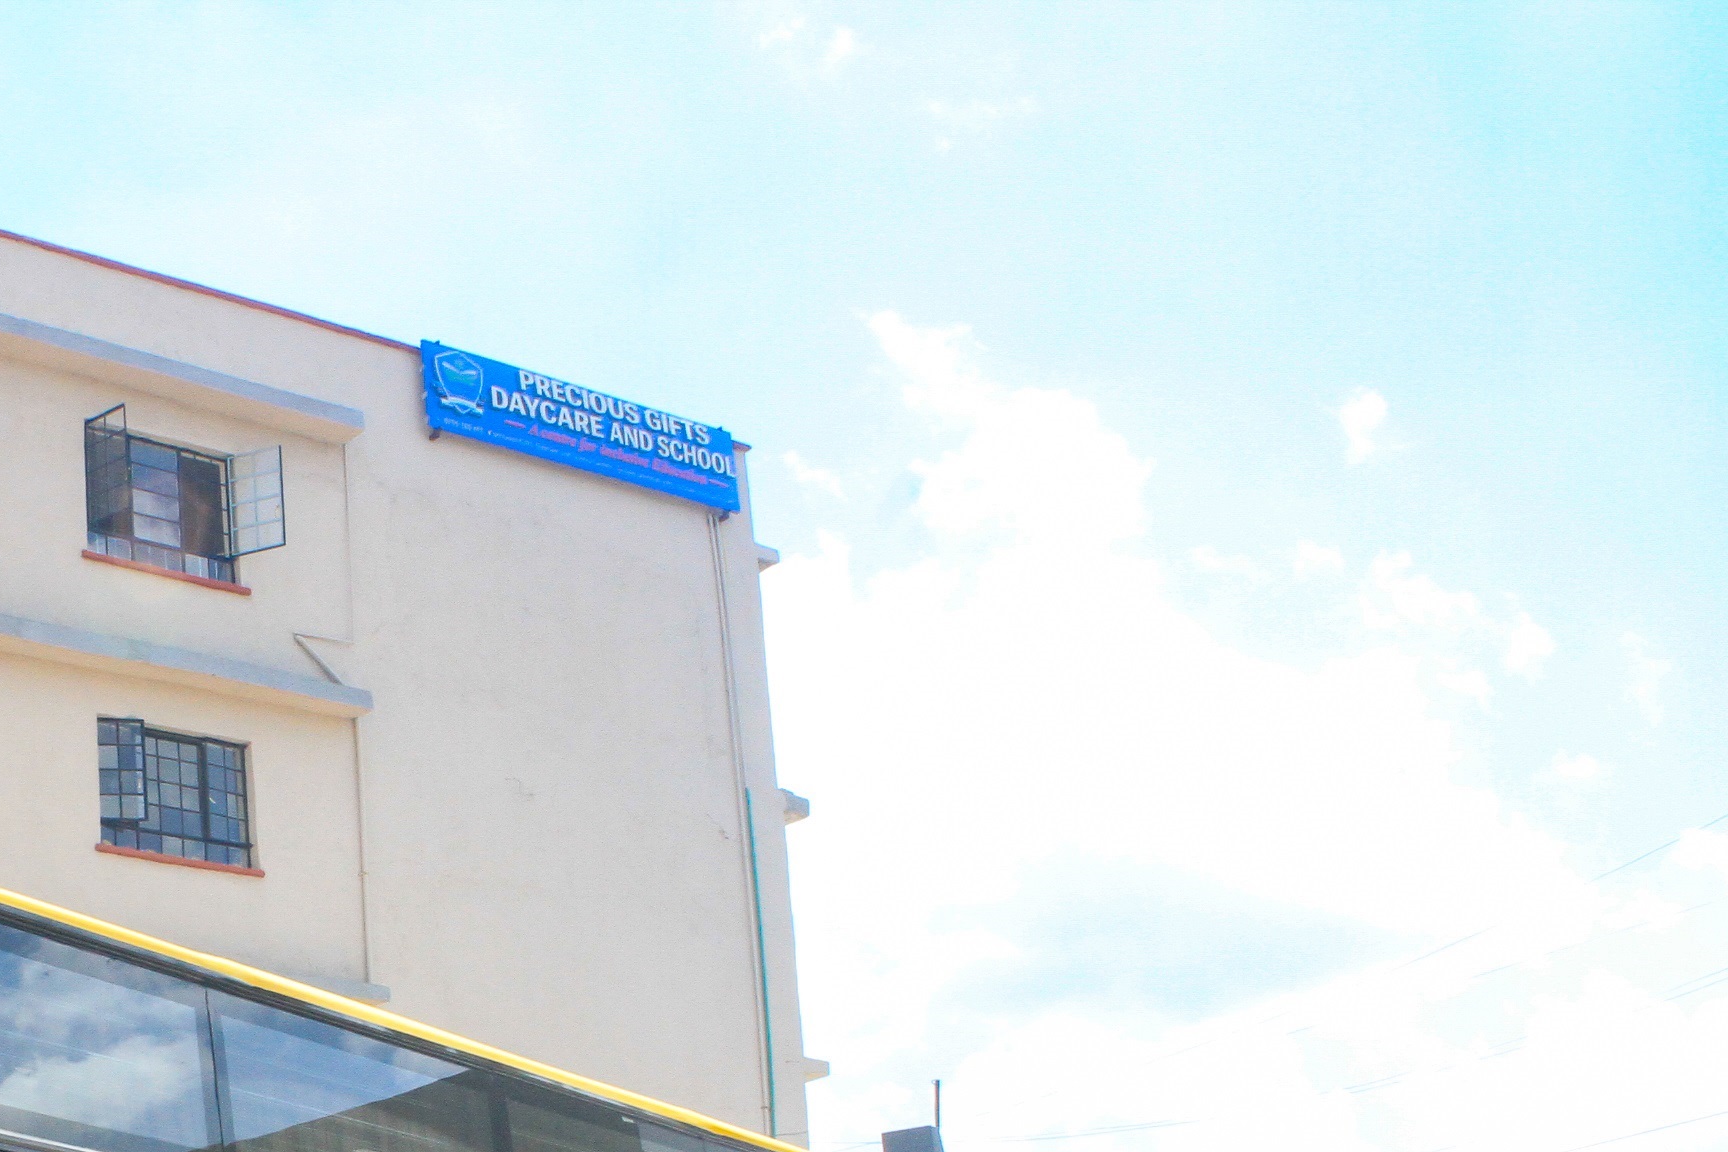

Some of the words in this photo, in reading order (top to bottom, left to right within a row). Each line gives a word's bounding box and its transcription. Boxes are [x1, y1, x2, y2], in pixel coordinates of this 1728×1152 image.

[490, 386, 605, 439] DAYCARE
[610, 421, 654, 451] AND
[657, 435, 737, 478] SCHOOL
[519, 370, 640, 424] PRECIOUS
[644, 408, 710, 445] GIFTS
